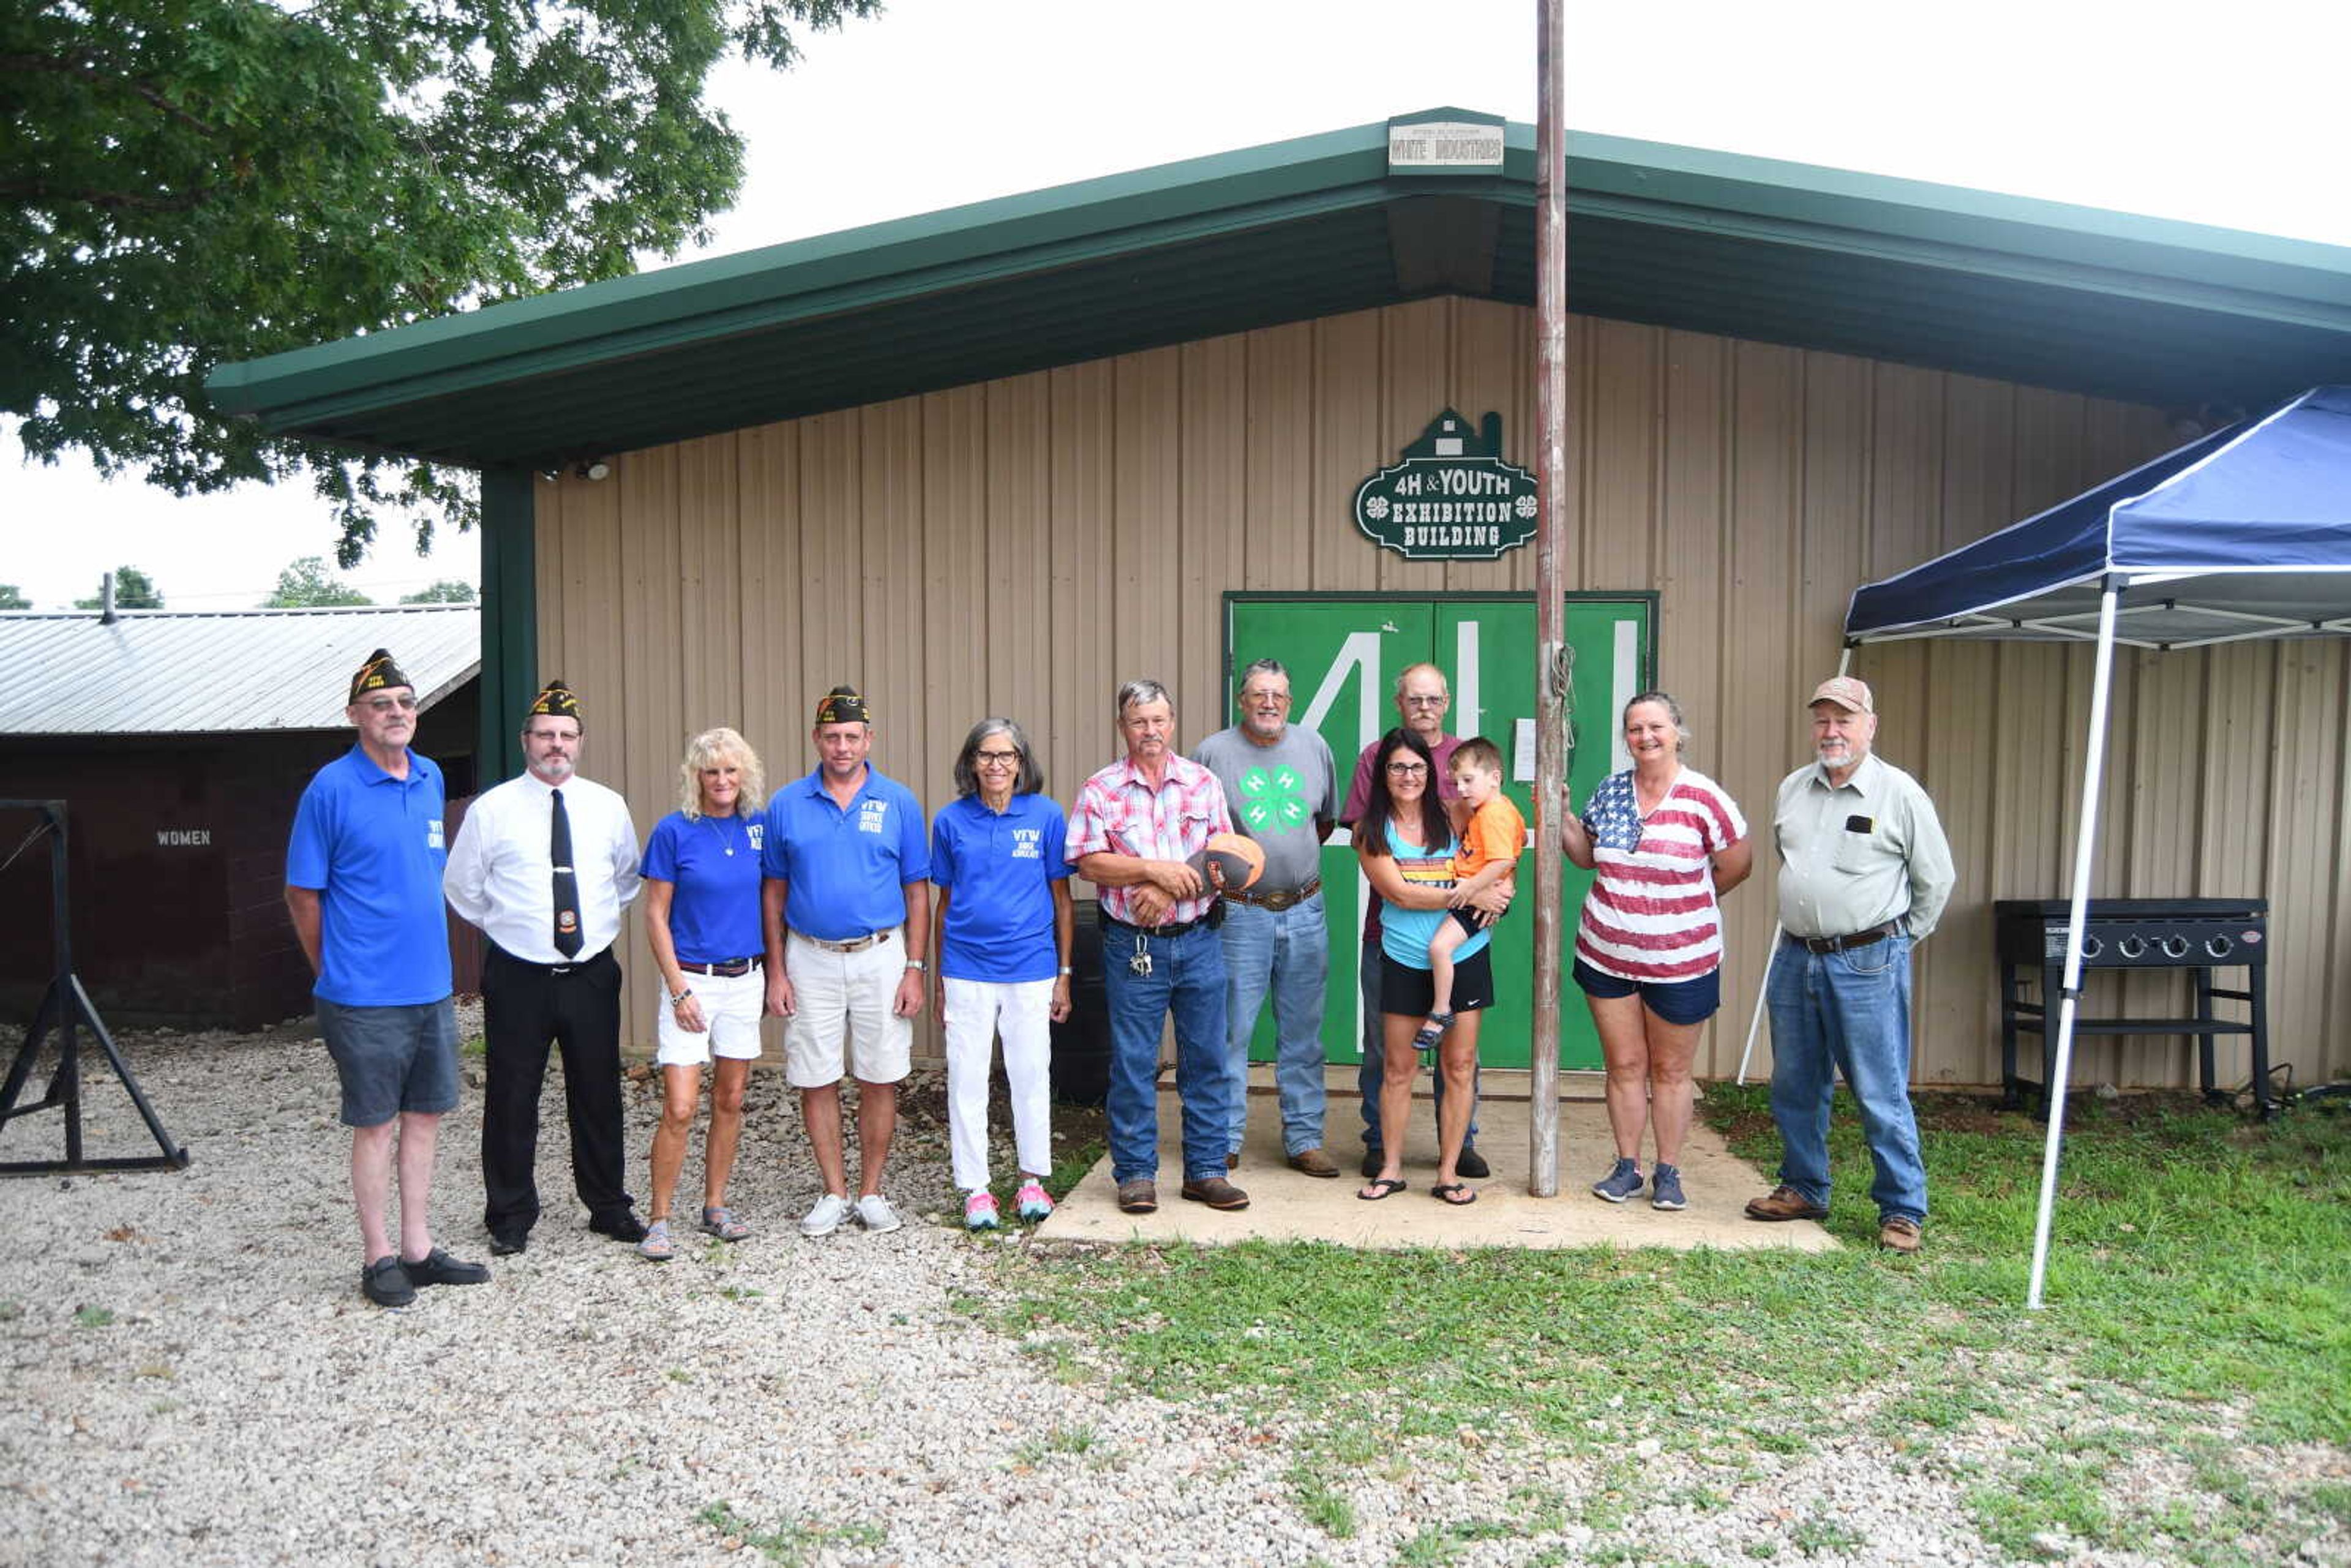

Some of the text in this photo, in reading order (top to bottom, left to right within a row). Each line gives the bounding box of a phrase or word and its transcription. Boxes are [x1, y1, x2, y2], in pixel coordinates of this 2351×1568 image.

[1395, 469, 1510, 495] 4H & YOUTH
[1393, 503, 1512, 523] EXHIBITION
[1404, 526, 1500, 546] BUILDING
[157, 830, 211, 846] WOMEN
[1012, 829, 1040, 841] VFW
